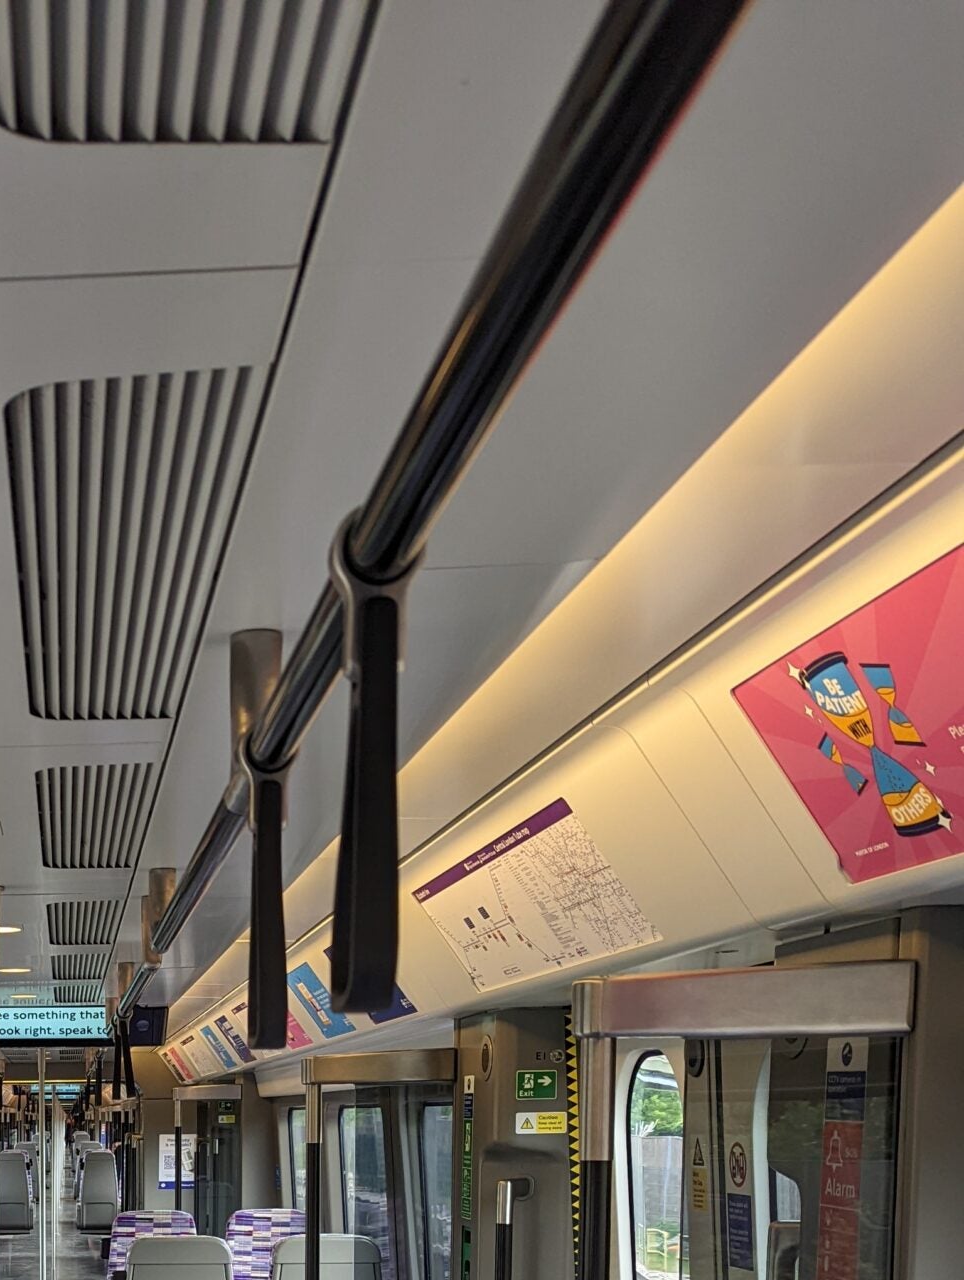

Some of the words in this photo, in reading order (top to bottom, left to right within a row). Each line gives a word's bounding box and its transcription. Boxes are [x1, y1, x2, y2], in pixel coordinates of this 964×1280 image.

[822, 677, 845, 697] BE
[815, 689, 868, 715] PATIENT
[847, 718, 872, 739] WITH
[948, 724, 964, 740] Ple
[891, 787, 933, 824] OTHERS
[13, 1010, 76, 1022] something
[80, 1010, 105, 1020] that
[59, 1026, 93, 1037] speak
[97, 1027, 108, 1036] to
[825, 1177, 856, 1199] Alarm
